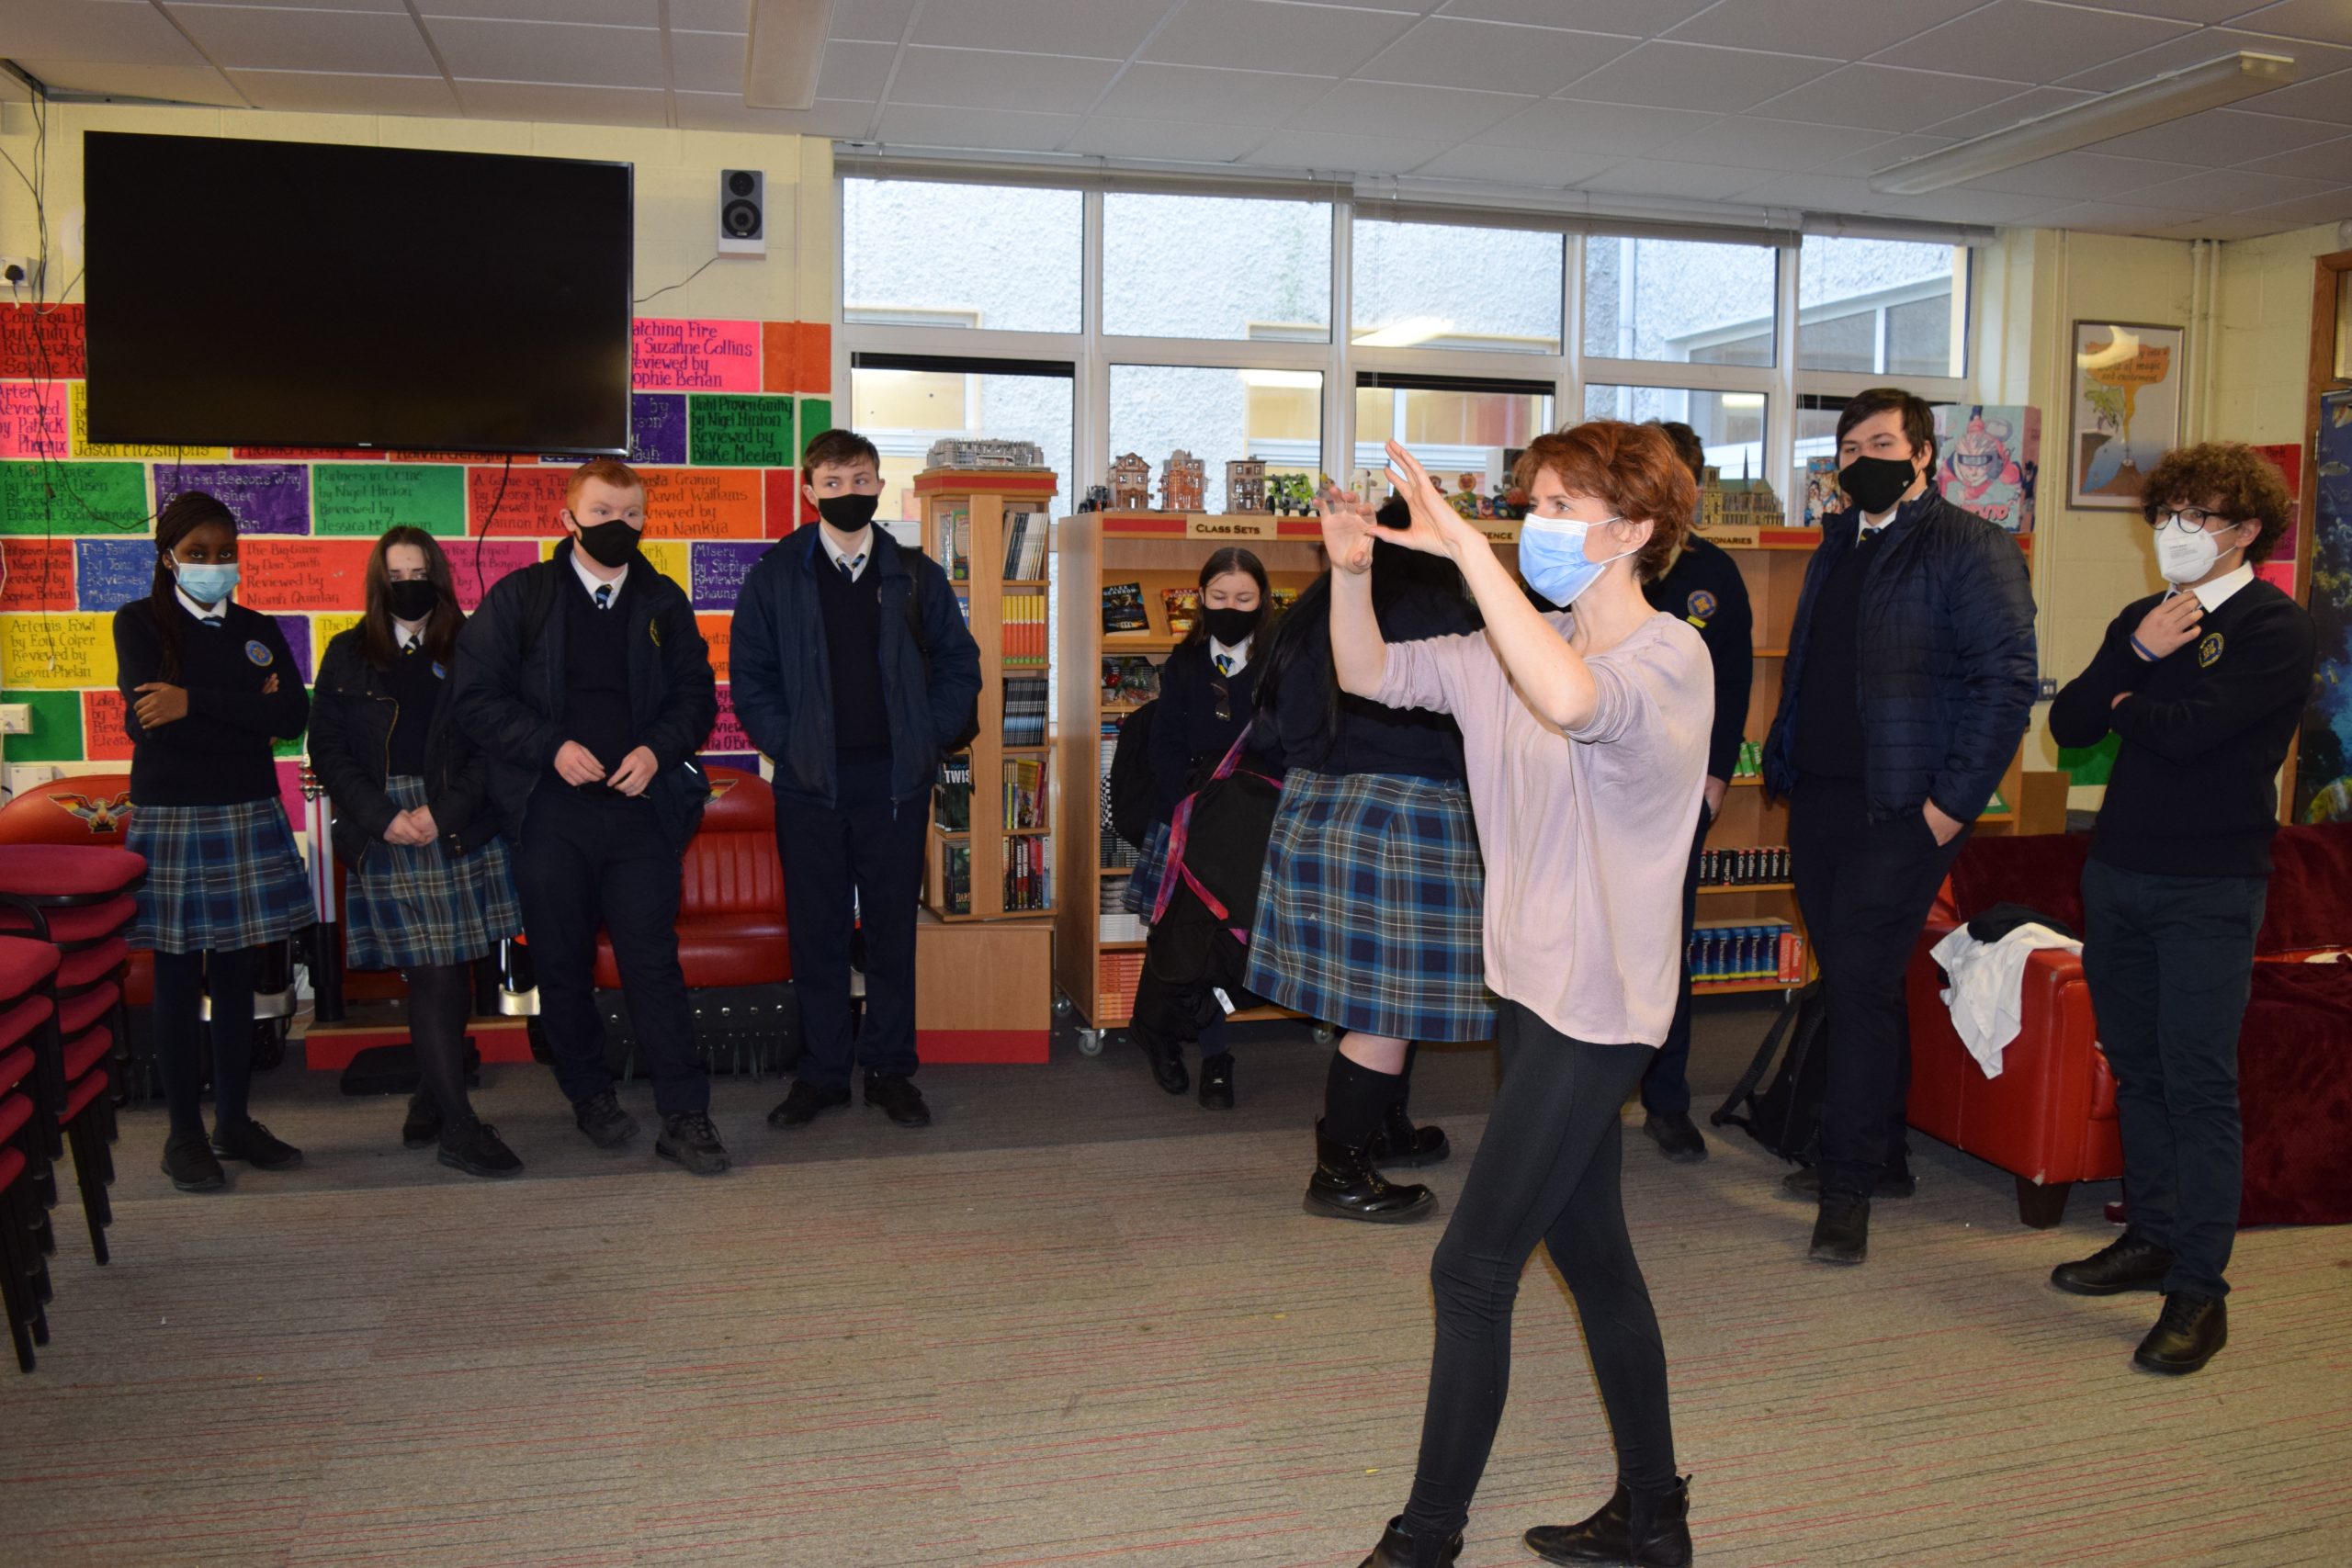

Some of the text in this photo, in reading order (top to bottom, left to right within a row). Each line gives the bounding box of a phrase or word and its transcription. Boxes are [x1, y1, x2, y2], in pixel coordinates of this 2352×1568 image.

[632, 321, 718, 344] atching Fire
[645, 337, 701, 355] Suzanne
[704, 338, 753, 357] Collins
[632, 355, 709, 376] eviewed by
[632, 369, 724, 389] ophie Behan
[738, 412, 782, 427] Hinton
[691, 427, 775, 448] Reviewed by
[473, 473, 485, 487] A
[674, 471, 721, 490] Granny
[690, 486, 750, 502] Walliams
[645, 503, 695, 520] viewed
[321, 518, 366, 533] Jessica
[1482, 531, 1513, 540] ENCE
[246, 571, 324, 592] Reviewed by
[10, 617, 96, 634] Artemis Fowl
[71, 647, 88, 665] by
